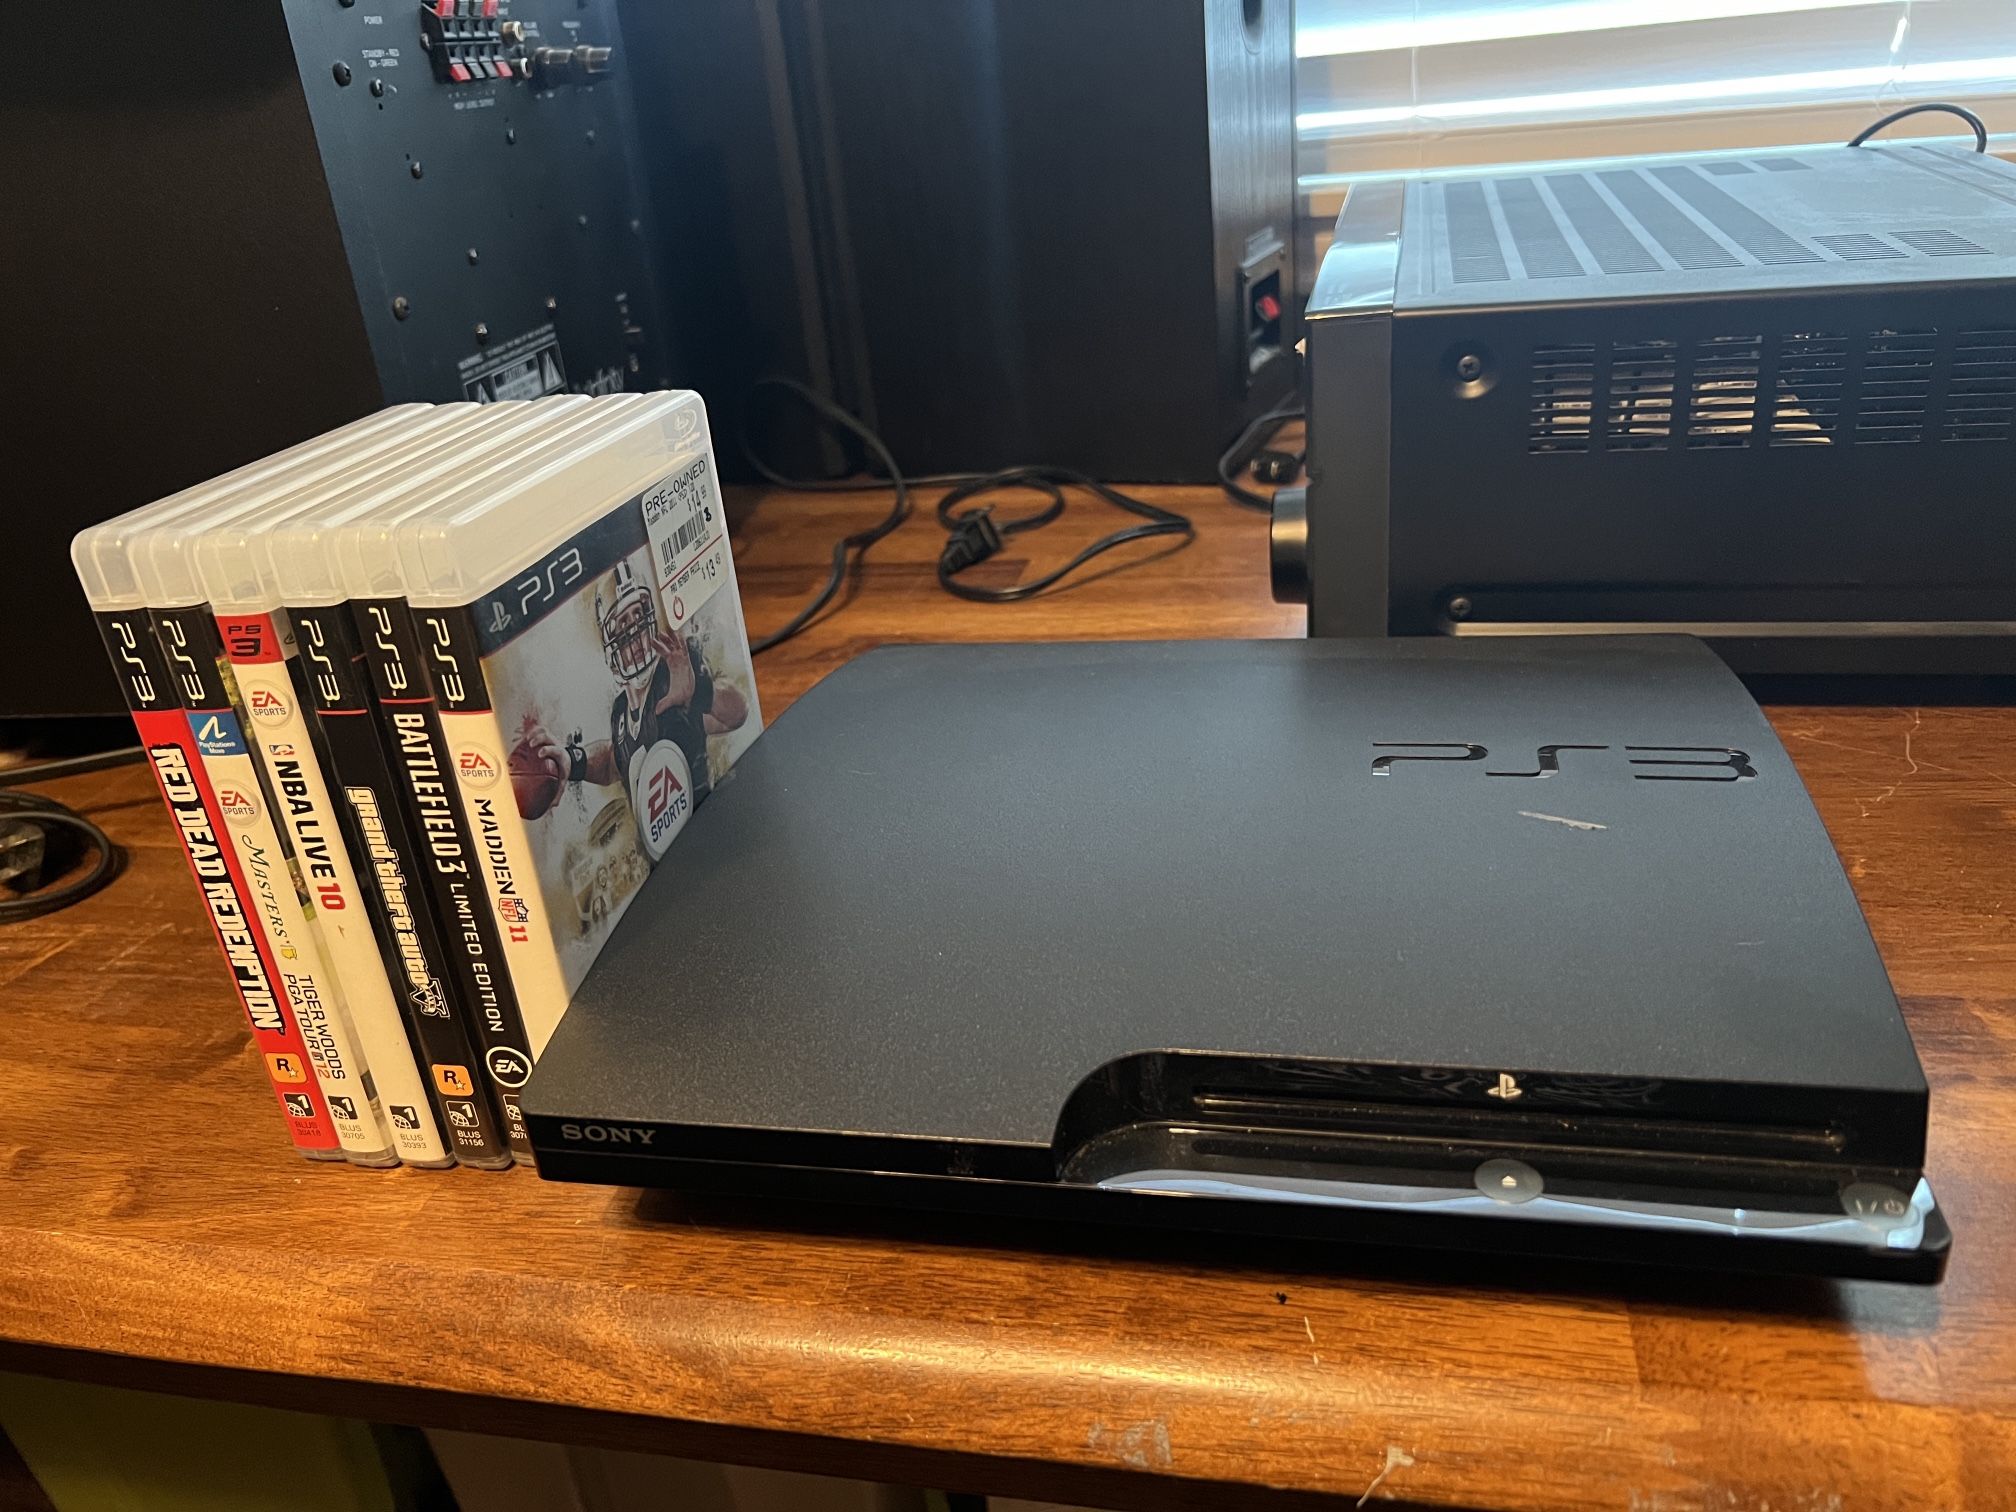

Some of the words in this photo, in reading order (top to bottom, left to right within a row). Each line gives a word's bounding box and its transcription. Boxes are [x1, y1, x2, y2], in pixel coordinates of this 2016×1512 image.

[645, 460, 706, 517] PRE-OWNED
[517, 547, 583, 616] PS3
[112, 621, 155, 701] PS3
[163, 620, 205, 700] PS3
[301, 619, 340, 701] PS3
[368, 607, 408, 690] PS3
[426, 618, 465, 702] PS3
[251, 691, 284, 708] EA
[253, 707, 287, 716] SPORTS
[151, 748, 198, 802] RED
[460, 753, 491, 769] EA
[461, 769, 495, 778] SPORTS
[1371, 743, 1758, 782] PS3
[221, 790, 252, 806] EA
[393, 713, 462, 857] BATTLEFIELD
[648, 765, 683, 825] EA
[222, 807, 255, 815] SPORTS
[650, 792, 688, 842] SPORTS
[174, 808, 226, 877] DEAD
[274, 760, 314, 816] NBA
[294, 820, 337, 879] LIVE
[317, 882, 346, 910] 10
[474, 798, 516, 895] MADDEN
[436, 859, 467, 874] 3
[450, 882, 482, 955] LIMITED
[501, 900, 517, 920] NFL
[508, 925, 529, 943] 11
[203, 882, 283, 1030] REDEMPTION
[284, 973, 304, 1006] PGA
[297, 1010, 321, 1051] TOUR
[472, 963, 504, 1032] EDITION
[298, 974, 325, 1022] TIGER
[318, 1025, 346, 1080] WOODS
[315, 1061, 330, 1079] 12
[495, 1059, 524, 1074] EA
[295, 1121, 318, 1129] BLUS
[340, 1123, 362, 1132] BLUS
[342, 1131, 365, 1140] 30705
[400, 1133, 423, 1141] BLUS
[457, 1129, 481, 1139] BLUS
[513, 1123, 525, 1132] BL
[561, 1123, 656, 1145] SONY
[402, 1141, 427, 1149] 30393
[459, 1138, 485, 1147] 31156
